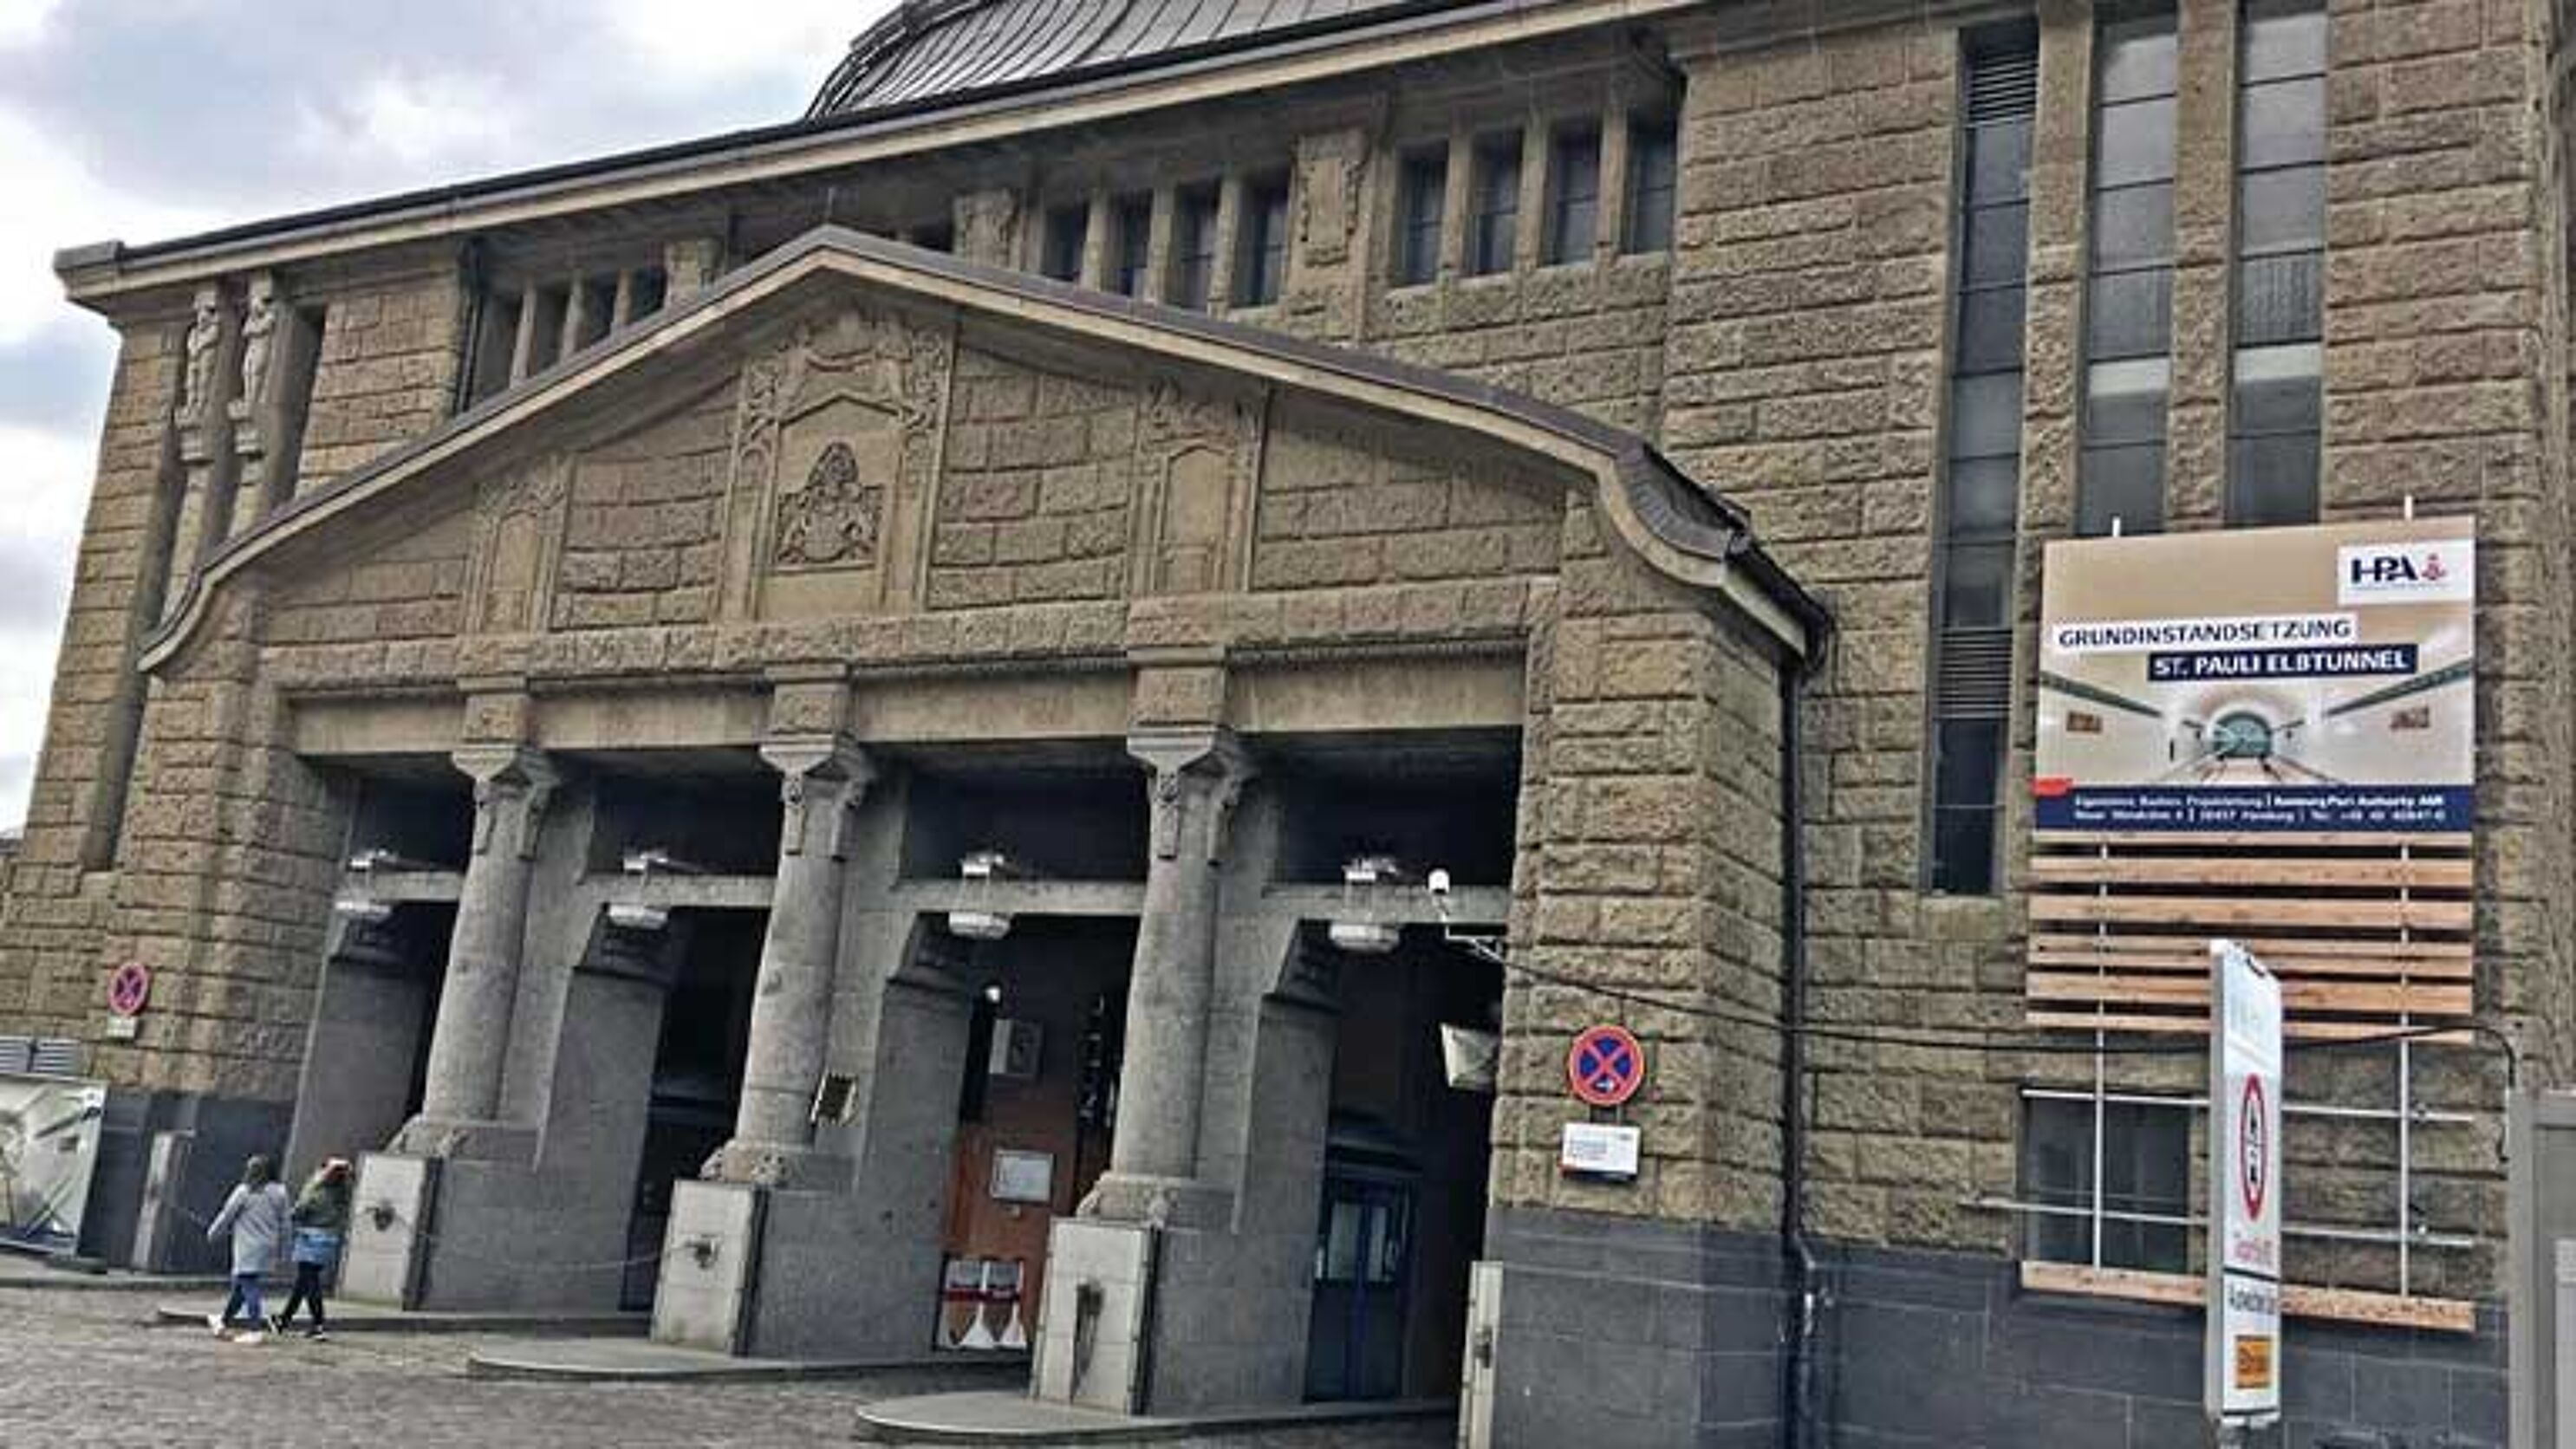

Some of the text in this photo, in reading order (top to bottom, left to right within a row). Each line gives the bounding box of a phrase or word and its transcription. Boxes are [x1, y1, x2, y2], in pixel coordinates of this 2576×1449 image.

[2351, 555, 2418, 584] HPA
[2059, 619, 2352, 648] GRUNDINSTANDSETZUNG
[2154, 649, 2408, 677] ST. PAULI ELBTUNNEL
